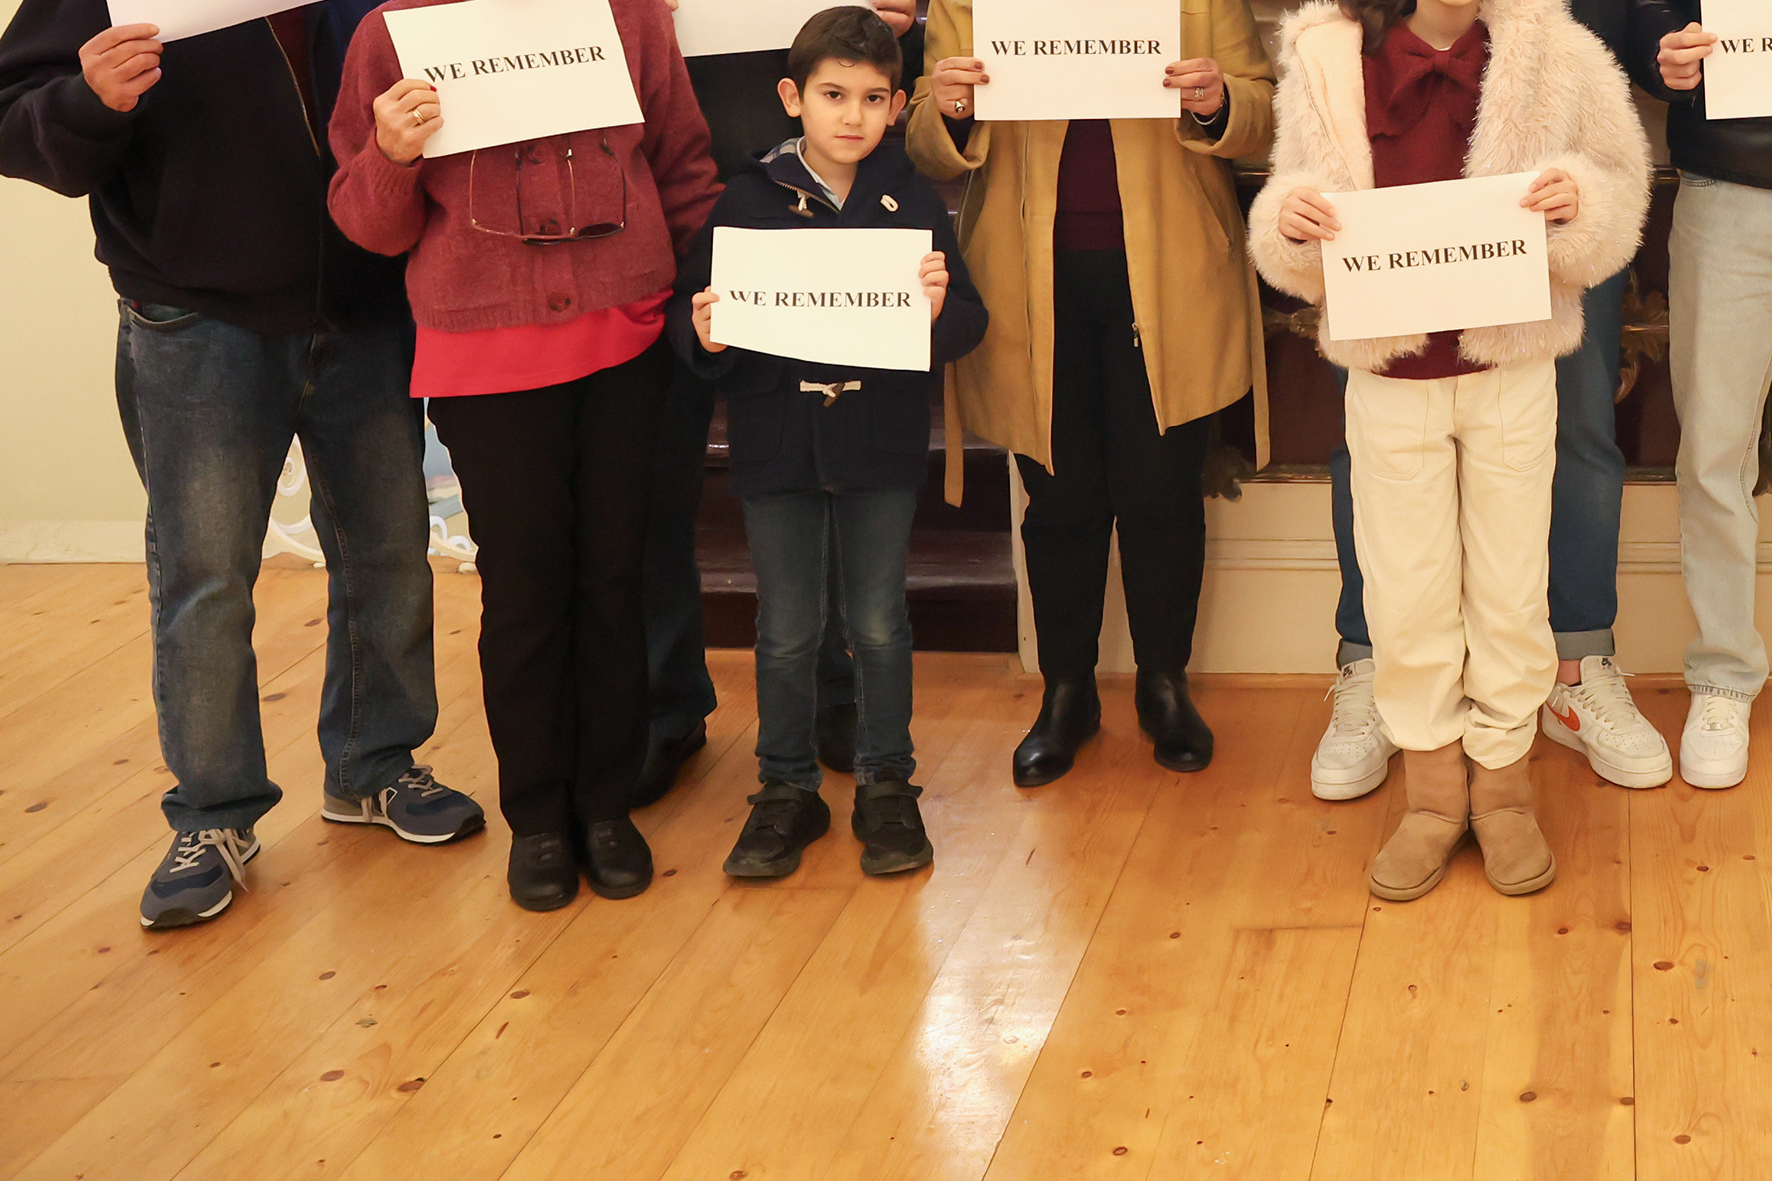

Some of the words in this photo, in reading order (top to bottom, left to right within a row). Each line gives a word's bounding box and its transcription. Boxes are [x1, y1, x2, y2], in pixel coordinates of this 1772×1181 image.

[991, 41, 1026, 55] WE
[1034, 40, 1161, 55] REMEMBER
[1720, 38, 1755, 54] WE
[424, 62, 466, 83] WE
[472, 46, 605, 75] REMEMBER
[1342, 255, 1381, 272] WE
[1389, 240, 1527, 269] REMEMBER
[730, 290, 766, 306] WE
[775, 292, 911, 307] REMEMBER
